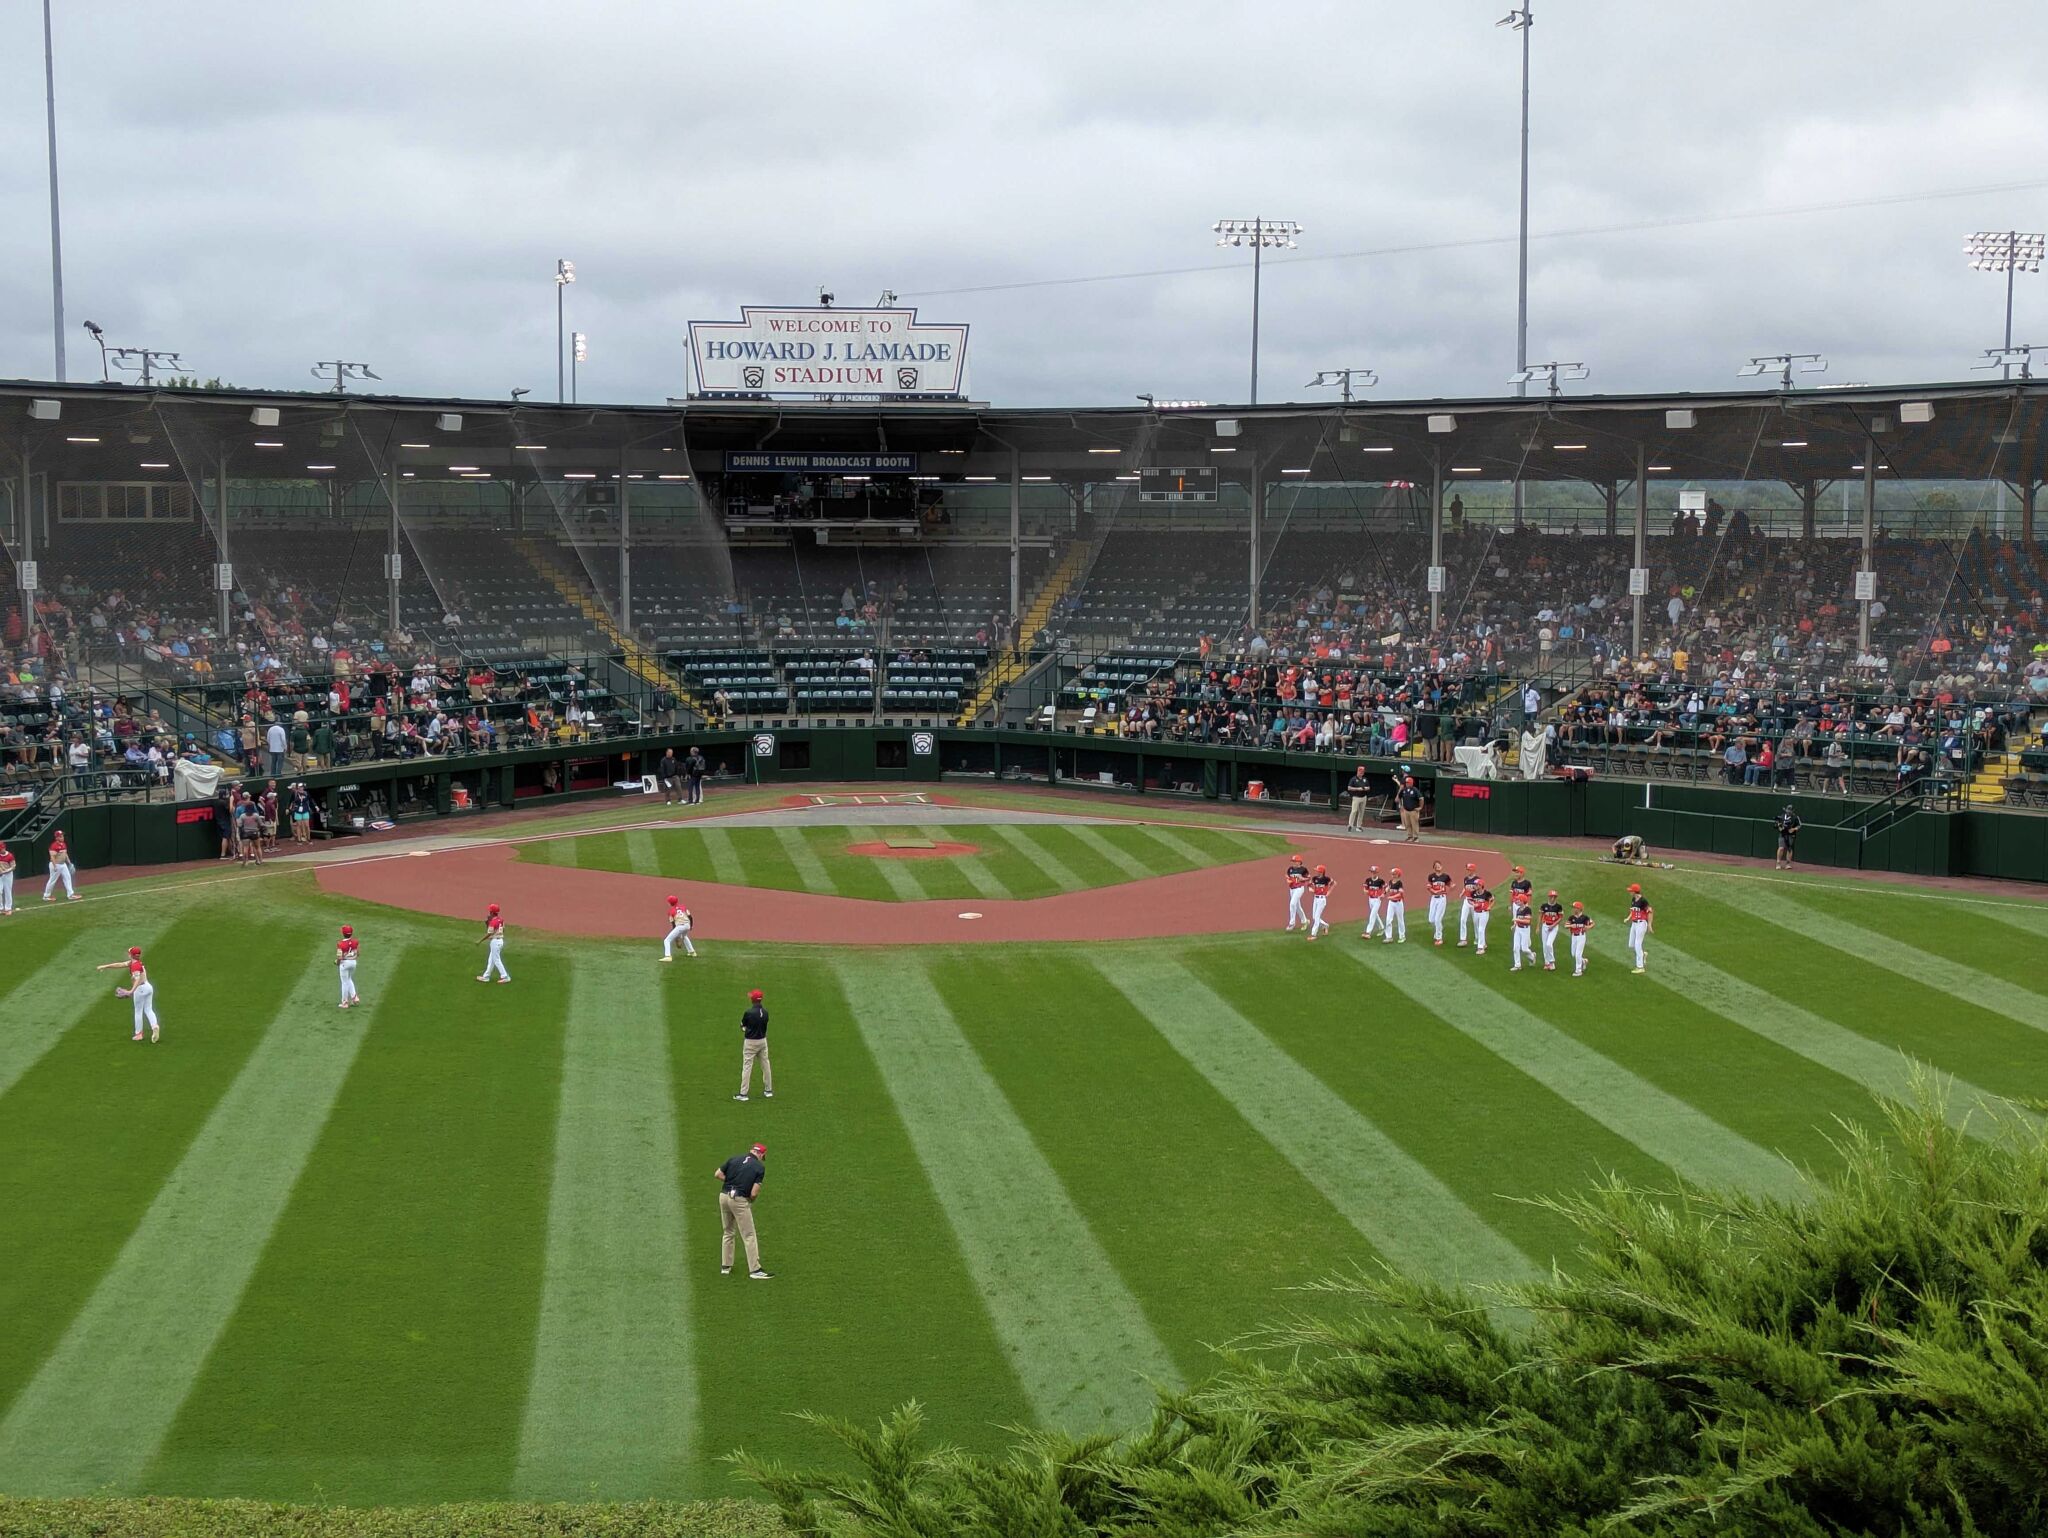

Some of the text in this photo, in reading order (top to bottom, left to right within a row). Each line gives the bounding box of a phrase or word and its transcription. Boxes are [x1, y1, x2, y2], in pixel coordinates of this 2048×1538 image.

[769, 320, 892, 333] WELCOME TO
[706, 341, 952, 361] HOWARD J. LAMADE
[774, 367, 883, 384] STADIUM
[733, 456, 910, 467] DENNIS LEWIN BROADCAST BOOTH
[1452, 784, 1490, 799] ESPN
[177, 806, 213, 823] ESPN
